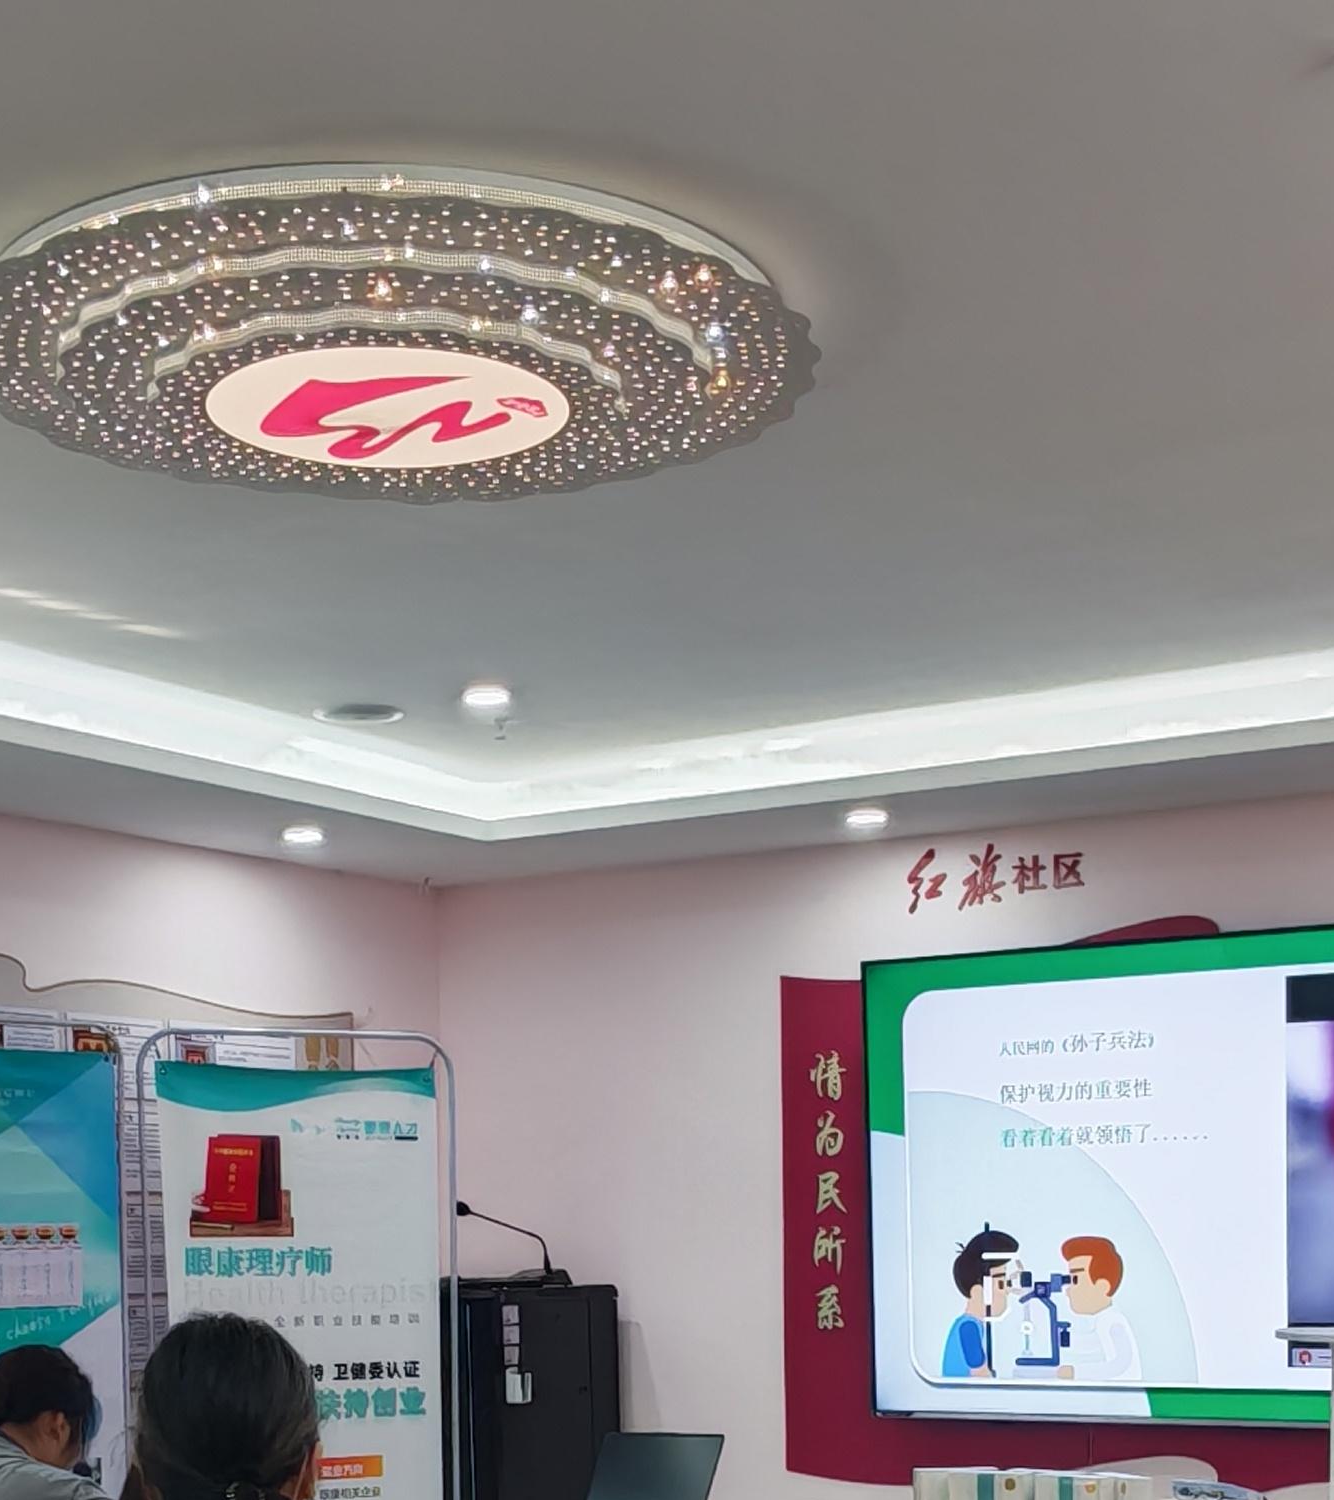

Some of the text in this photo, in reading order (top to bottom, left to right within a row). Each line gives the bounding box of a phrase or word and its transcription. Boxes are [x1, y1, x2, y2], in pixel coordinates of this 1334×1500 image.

[906, 842, 1086, 915] 红旗社区
[1000, 1078, 1153, 1105] 保护视力的重要性
[808, 1049, 848, 1331] 情为民所系
[184, 1246, 333, 1278] 眼康理疗师
[332, 1361, 421, 1381] 卫健委认证
